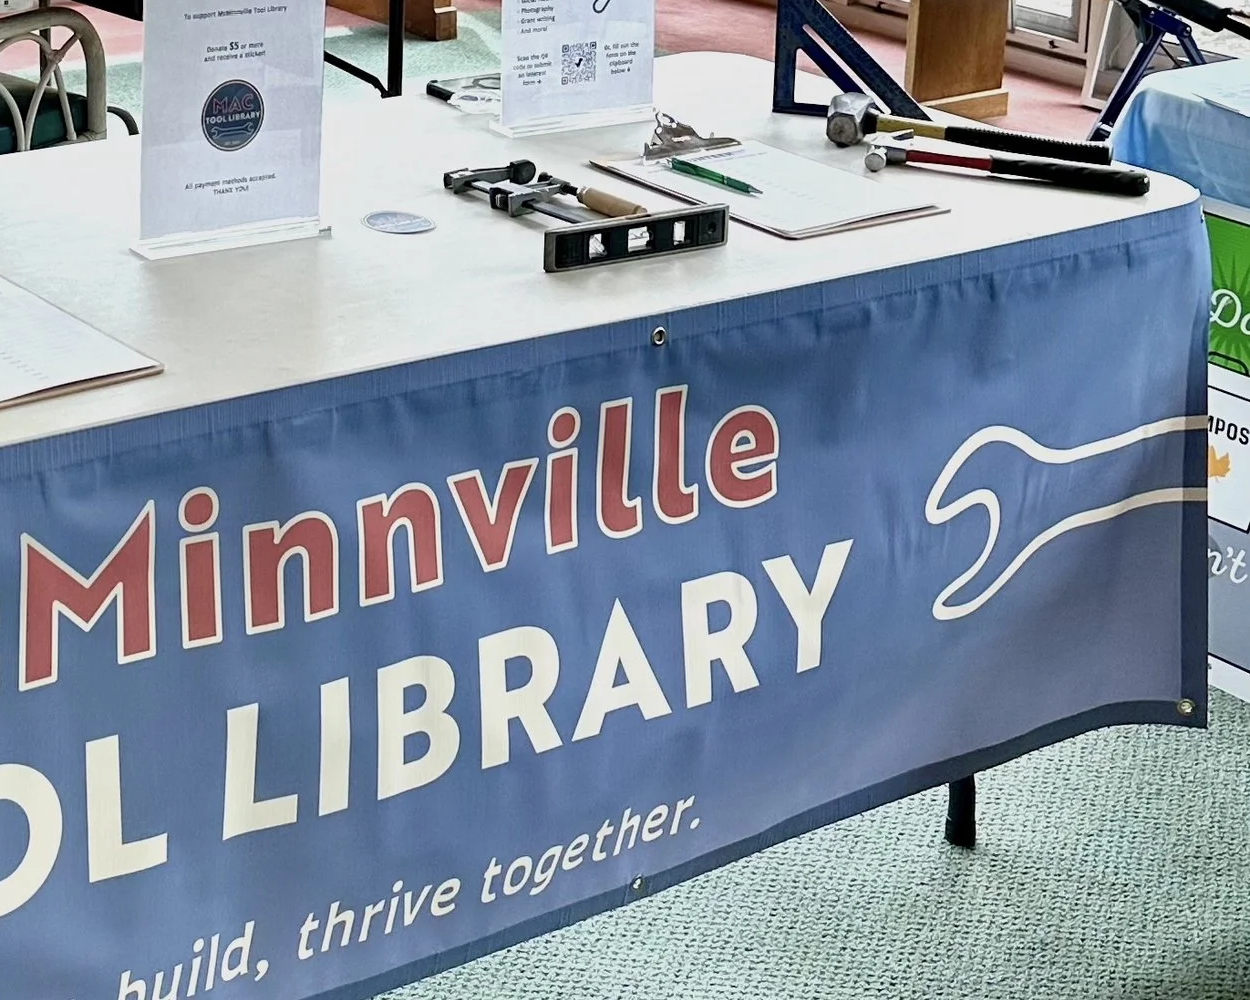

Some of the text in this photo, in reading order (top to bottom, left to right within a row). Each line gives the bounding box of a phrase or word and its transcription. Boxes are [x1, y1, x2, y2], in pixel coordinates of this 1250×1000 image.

[267, 5, 287, 13] Library
[229, 41, 239, 51] $5
[212, 93, 255, 115] MAC
[206, 110, 261, 125] TOOL LIBRARY
[221, 538, 854, 842] LIBRARY
[296, 875, 462, 962] thrive
[480, 794, 702, 904] together.
